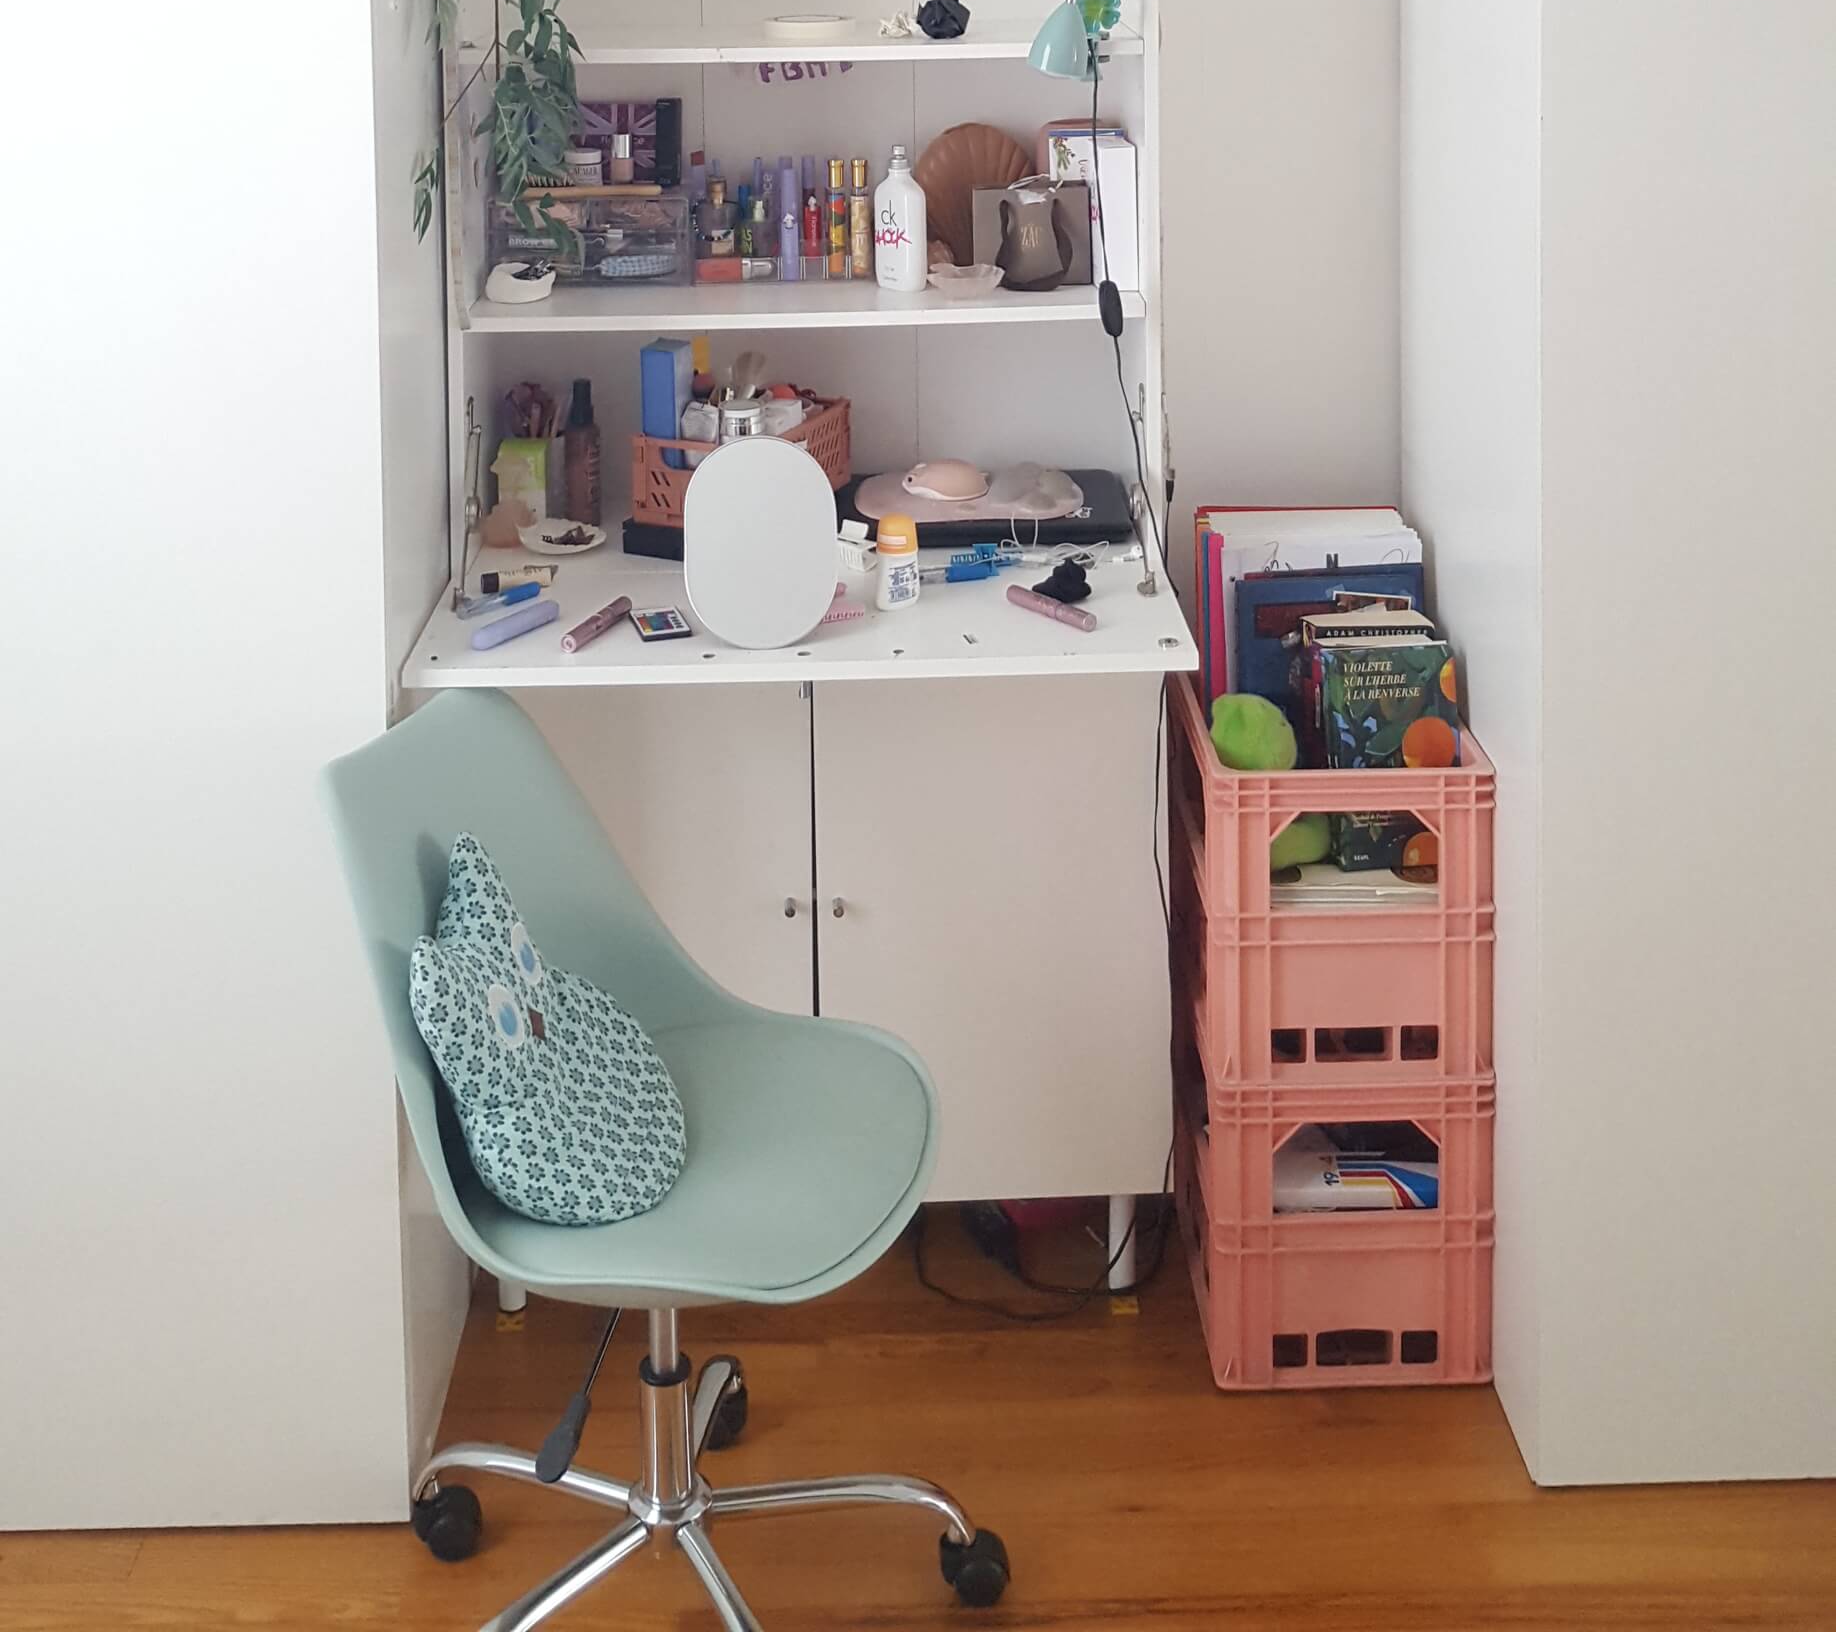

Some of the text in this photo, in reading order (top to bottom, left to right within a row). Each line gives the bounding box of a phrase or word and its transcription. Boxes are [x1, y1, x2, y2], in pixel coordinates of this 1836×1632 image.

[881, 200, 897, 226] ck
[1360, 628, 1428, 637] CHRISTOPHER
[1343, 661, 1393, 673] VIOLETTE
[1343, 674, 1407, 687] SUR L'HERBE
[1353, 690, 1366, 700] LA
[1367, 687, 1421, 700] RENVERSE
